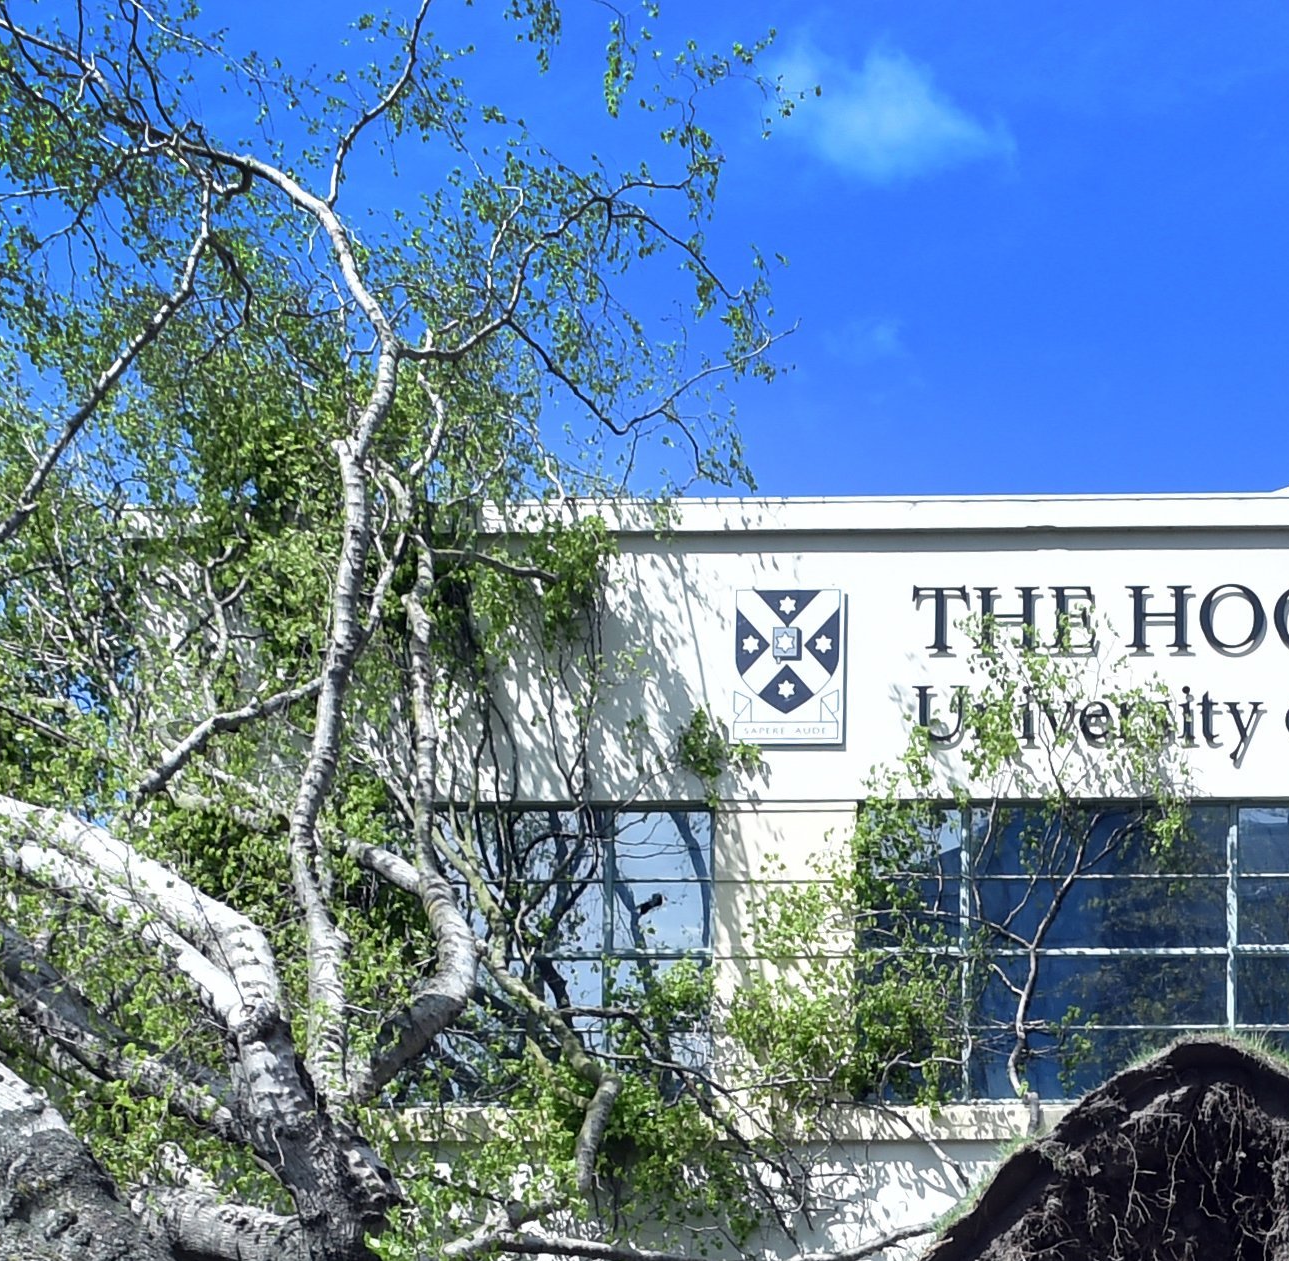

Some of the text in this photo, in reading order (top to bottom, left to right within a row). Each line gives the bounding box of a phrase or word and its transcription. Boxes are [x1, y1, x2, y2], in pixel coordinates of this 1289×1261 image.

[912, 584, 1096, 650] THE
[744, 727, 826, 735] SAPERE AUDE
